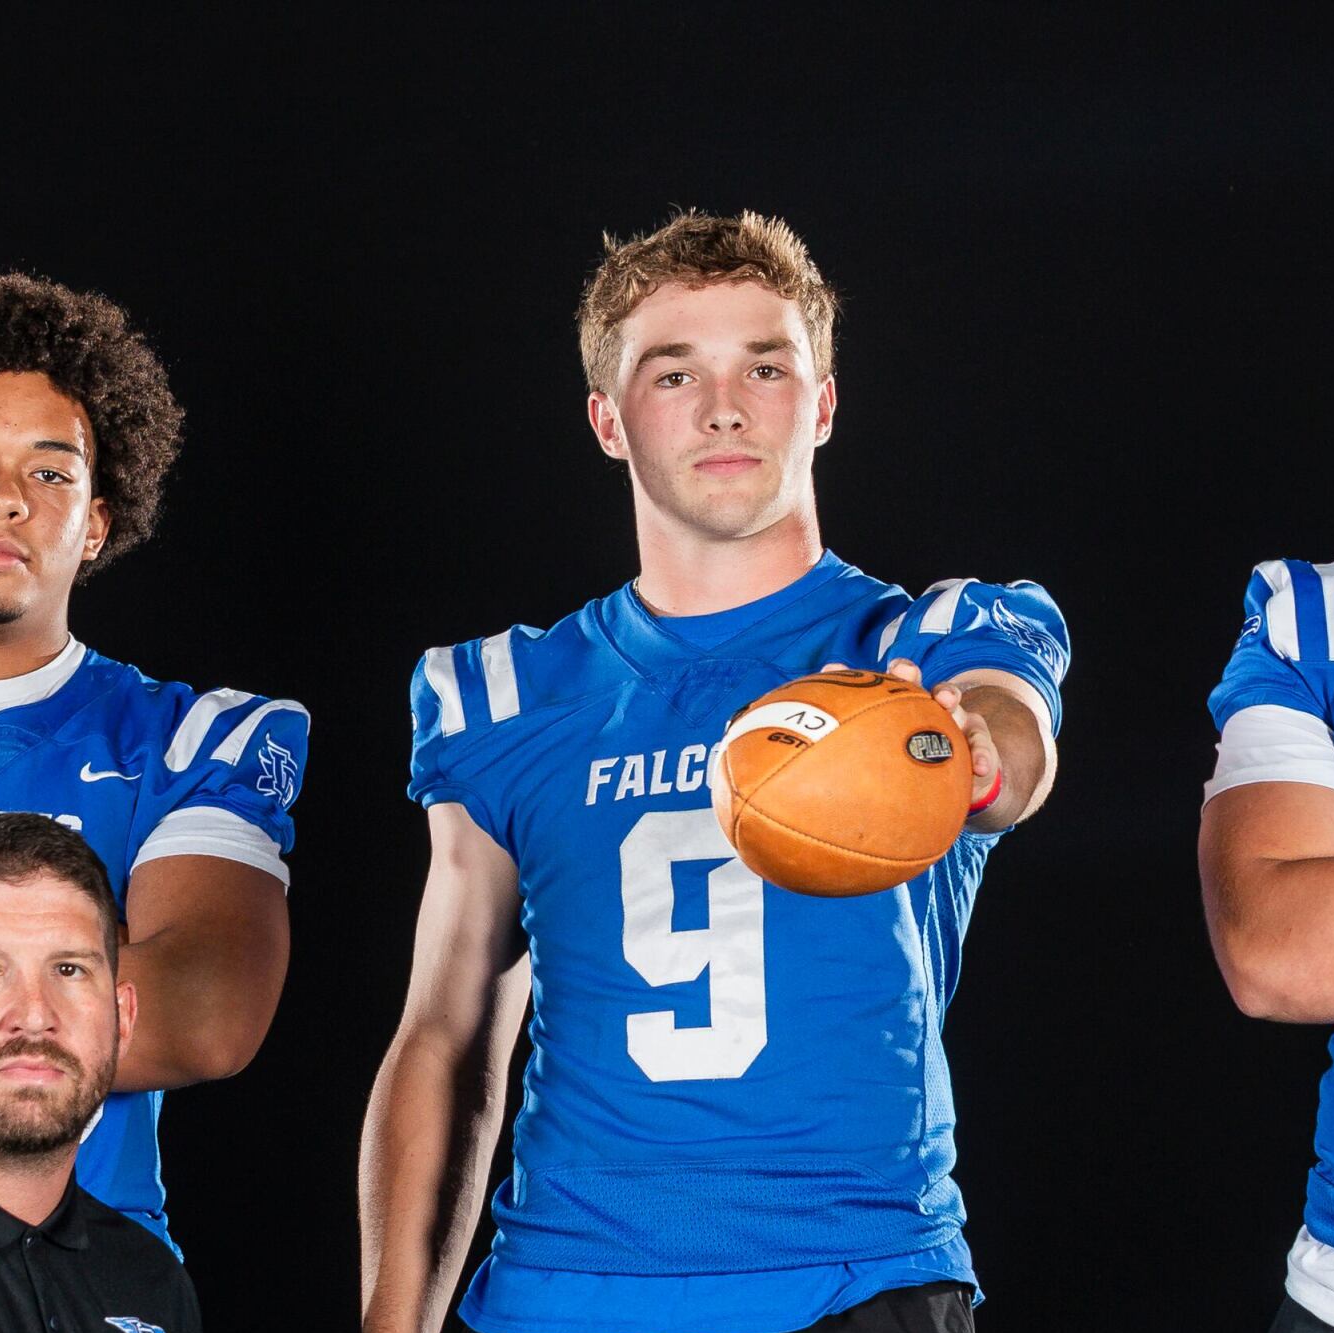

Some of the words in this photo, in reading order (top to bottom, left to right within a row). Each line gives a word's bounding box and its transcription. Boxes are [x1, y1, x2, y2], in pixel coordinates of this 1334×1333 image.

[784, 711, 826, 730] CV
[768, 732, 809, 748] GST
[619, 807, 768, 1083] 9
